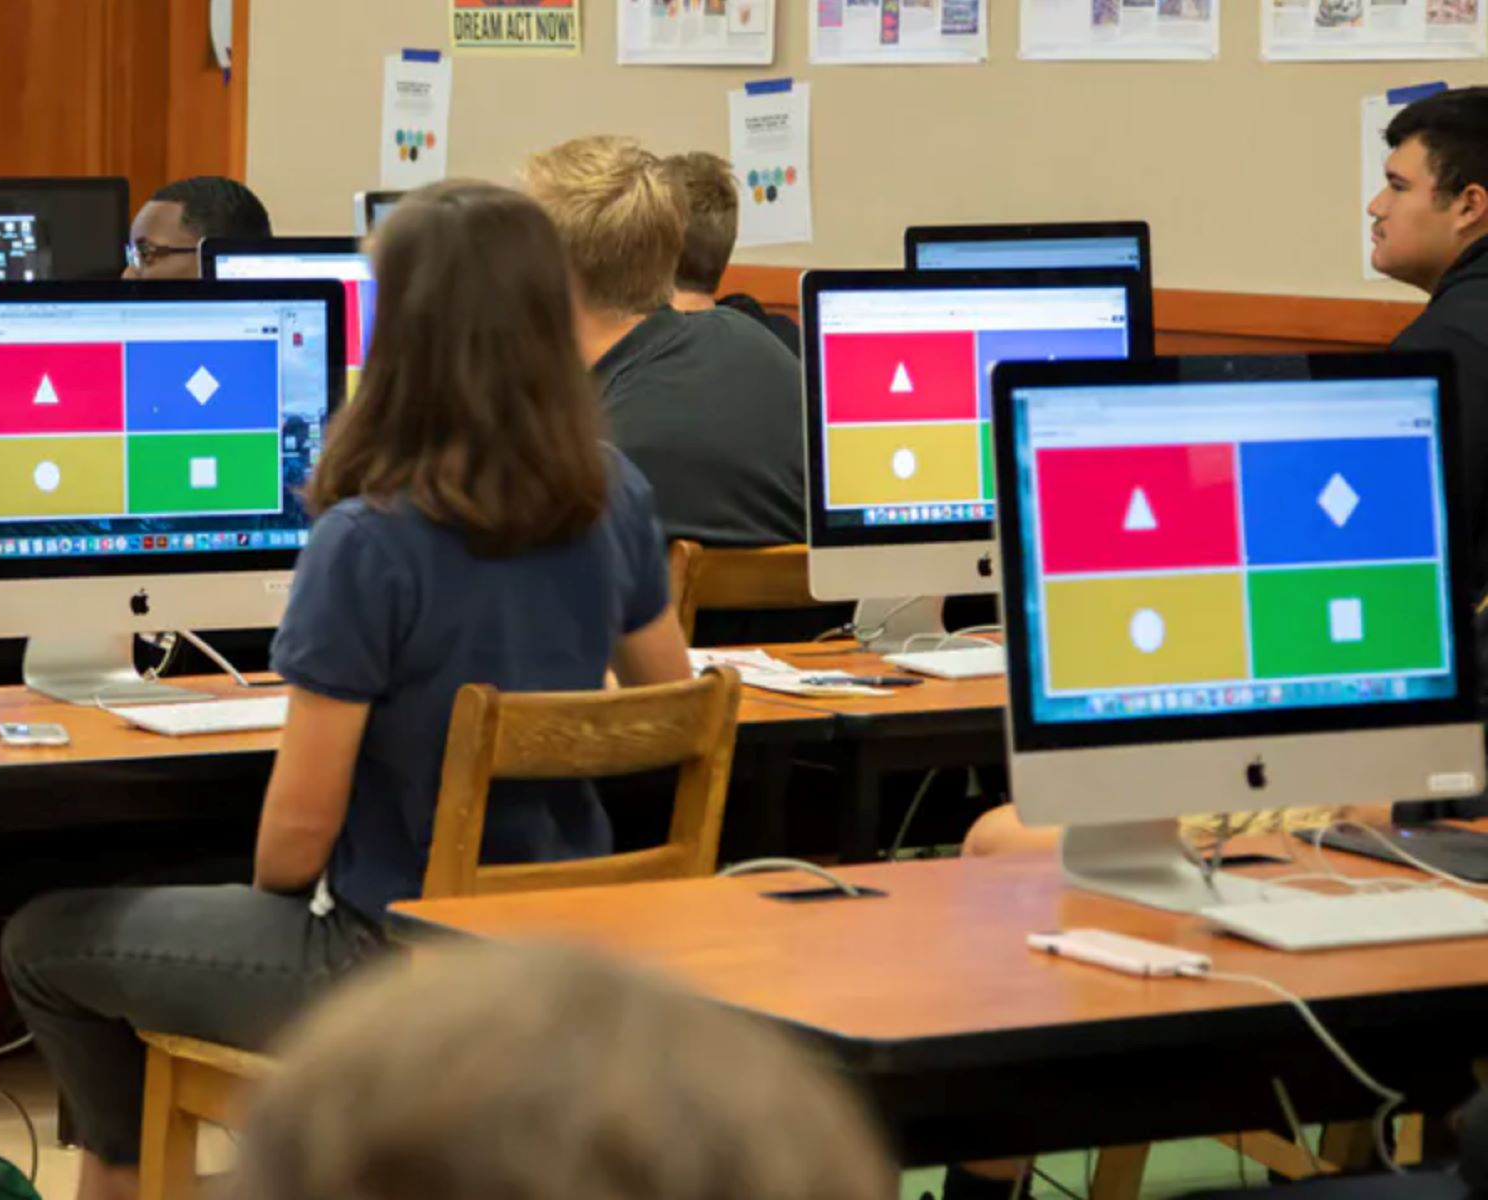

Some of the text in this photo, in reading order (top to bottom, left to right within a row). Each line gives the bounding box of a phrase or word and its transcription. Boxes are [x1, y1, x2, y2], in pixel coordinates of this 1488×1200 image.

[454, 11, 575, 41] DREAM ACT NOW!
